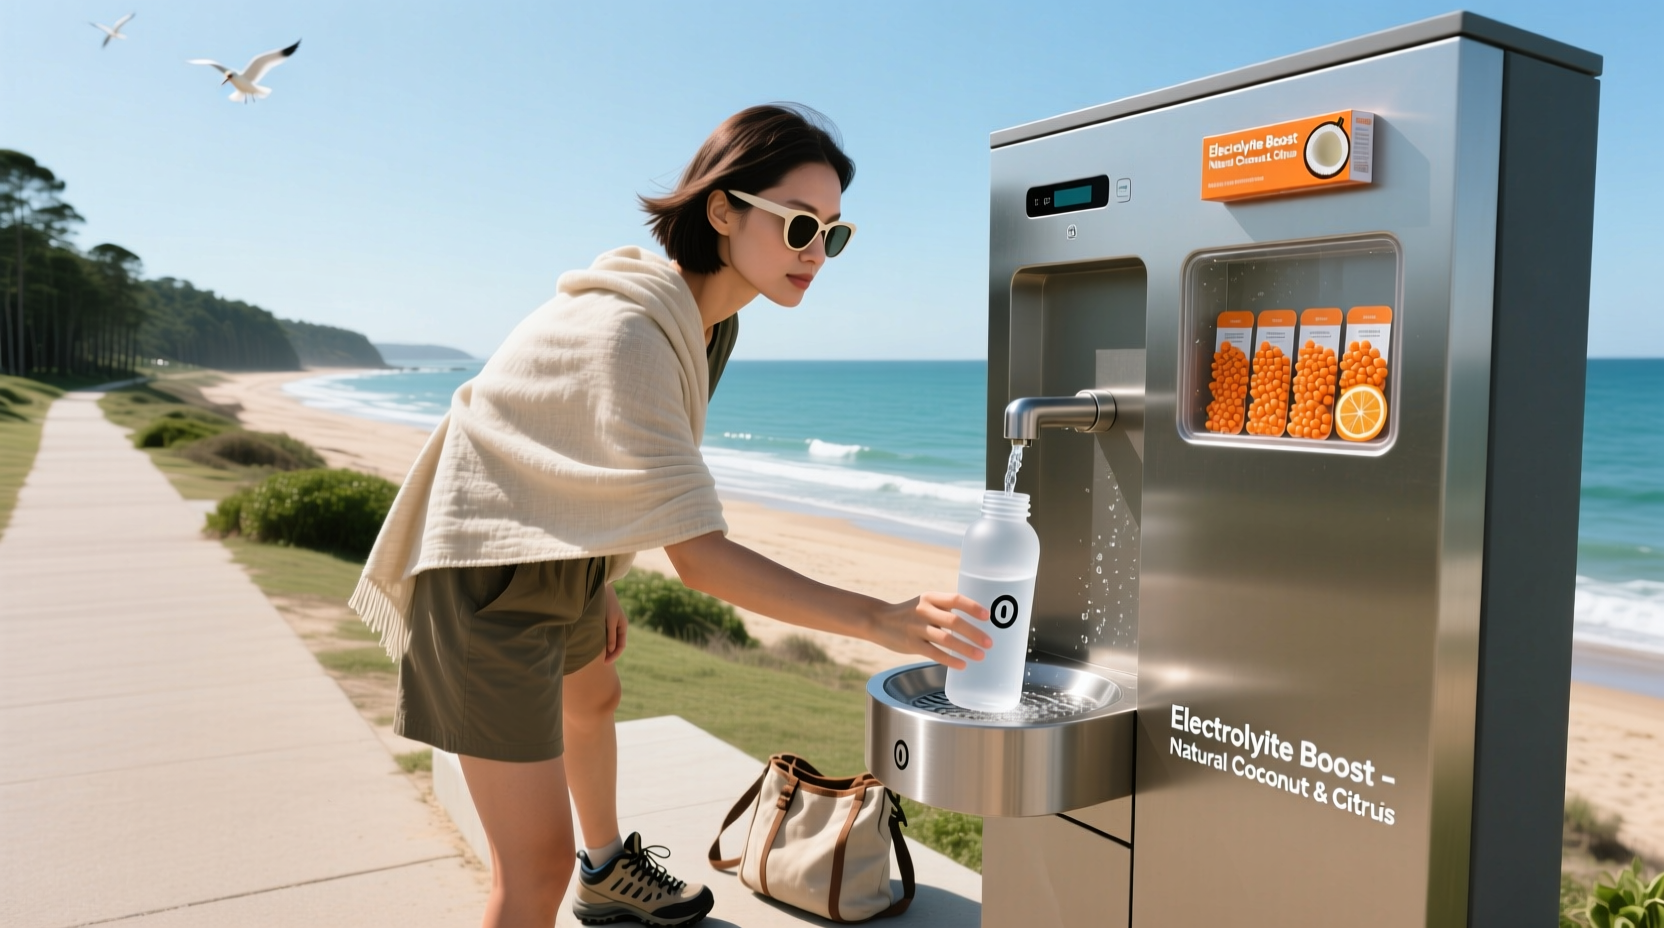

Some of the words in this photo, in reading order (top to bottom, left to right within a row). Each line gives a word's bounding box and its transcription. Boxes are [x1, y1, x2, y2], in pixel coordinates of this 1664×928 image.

[1169, 736, 1228, 772] Natural
[1231, 755, 1309, 798] Coconut
[1313, 781, 1328, 804] &
[1300, 740, 1375, 786] Boost
